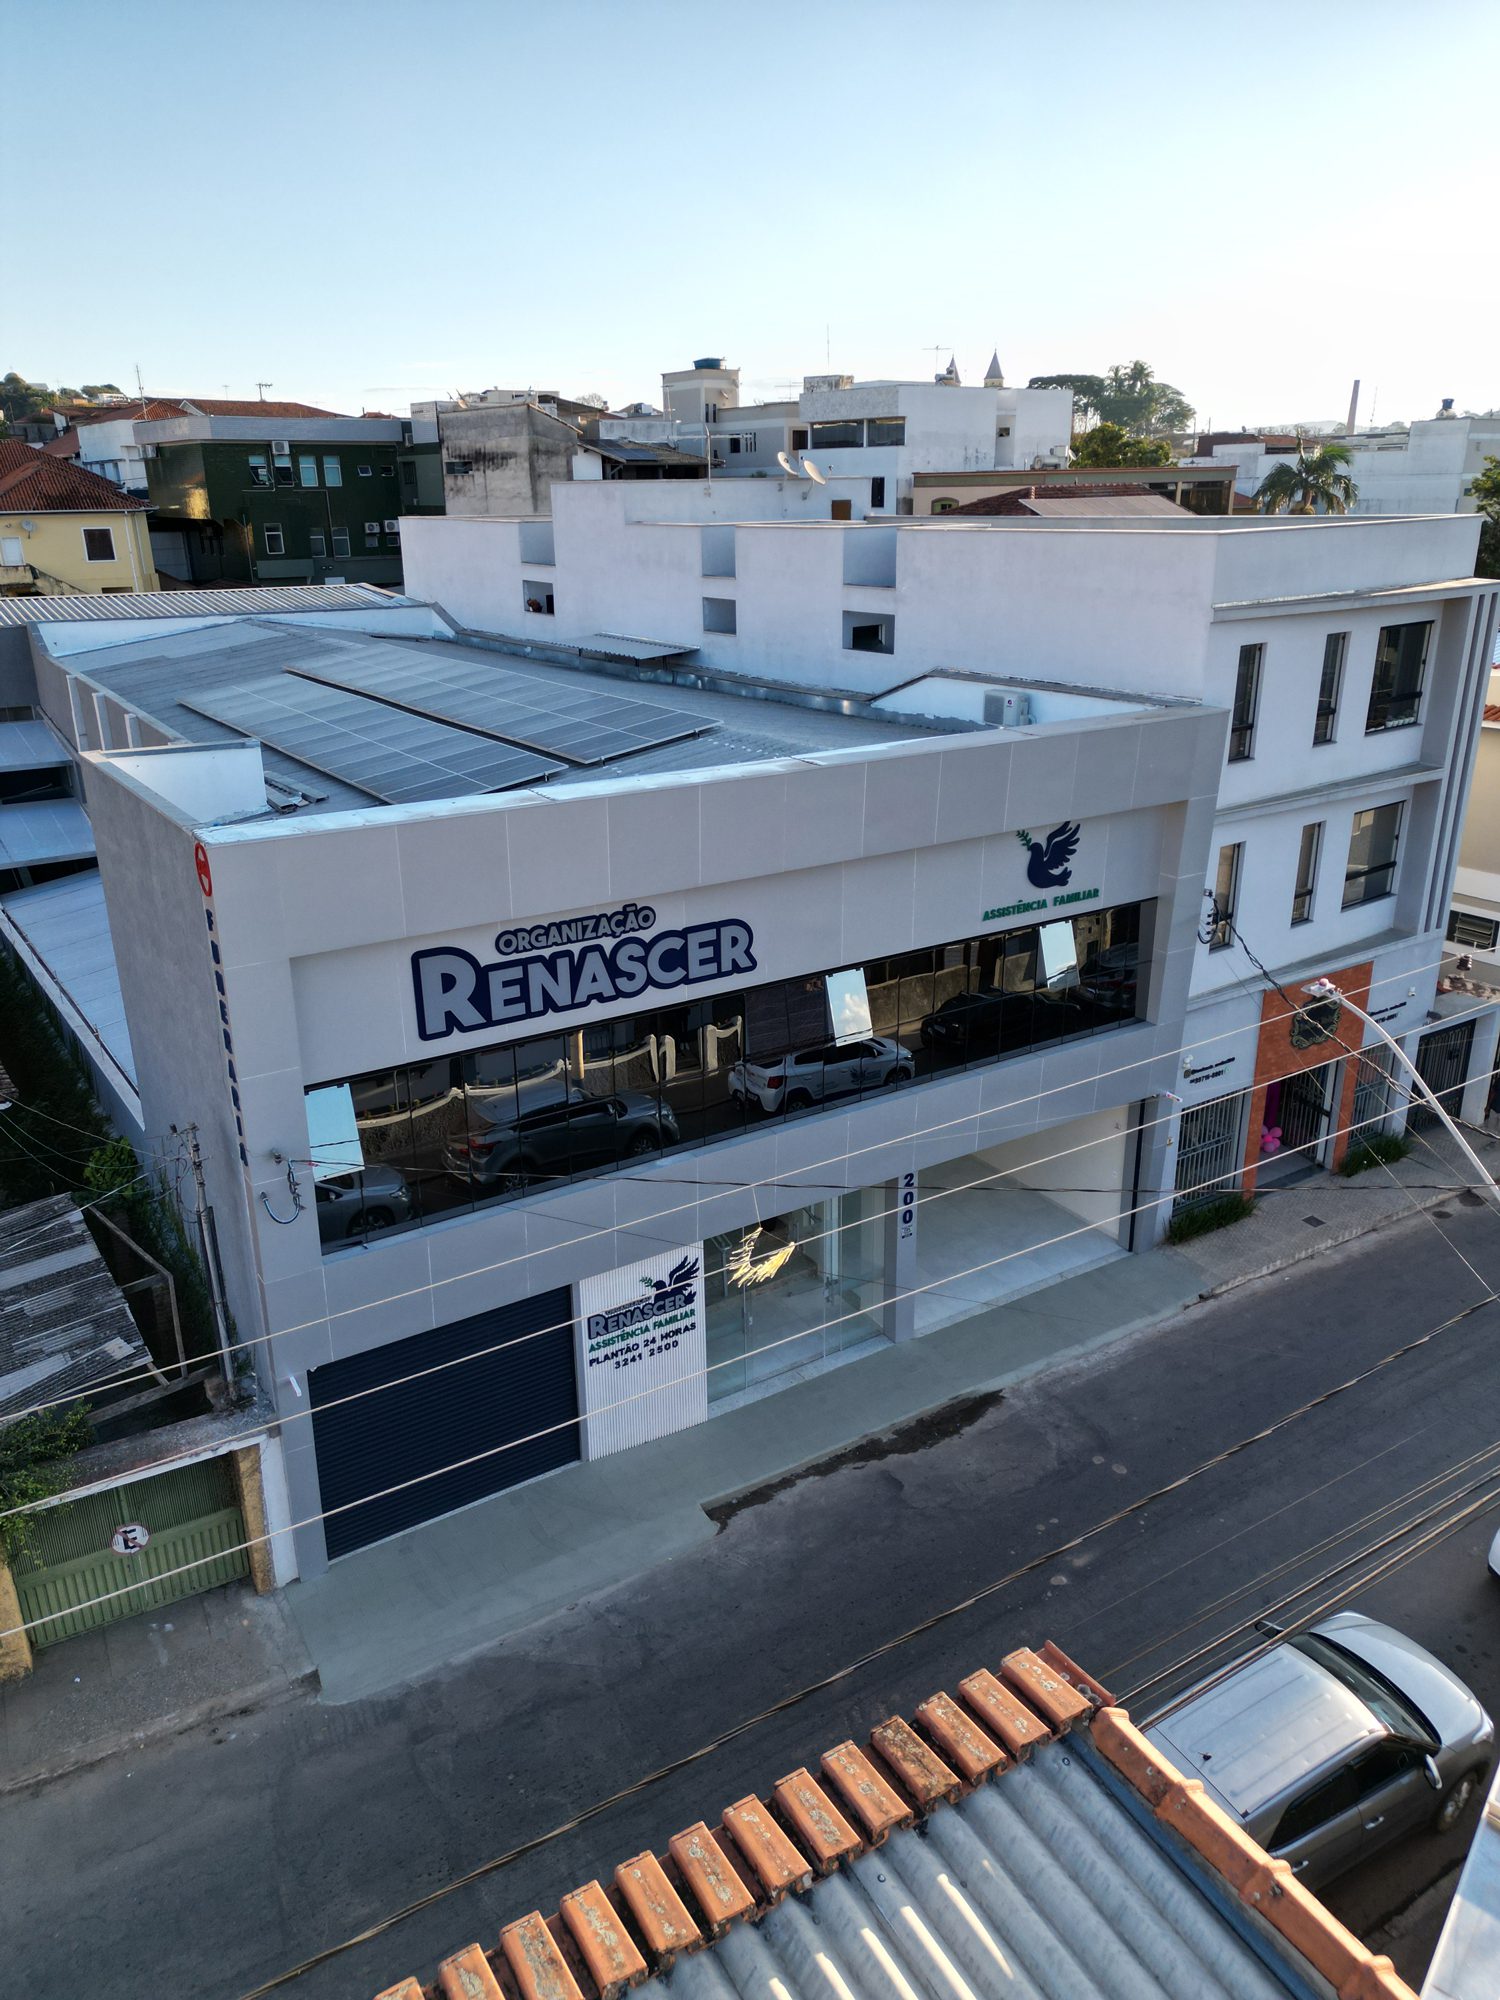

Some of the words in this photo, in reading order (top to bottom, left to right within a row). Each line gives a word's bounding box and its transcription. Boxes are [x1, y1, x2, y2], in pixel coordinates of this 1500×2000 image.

[982, 899, 1047, 921] ASSISTÊNCIA
[1053, 888, 1099, 906] FAMILIAR
[496, 904, 656, 954] ORGANIZAÇÃO
[902, 1172, 914, 1225] 200
[589, 1325, 650, 1353] ASSISTÊNCIA
[653, 1308, 696, 1331] FAMILIAR
[589, 1343, 640, 1367] PLANTÃO
[643, 1336, 657, 1348] 24
[660, 1322, 696, 1341] HORAS
[614, 1353, 643, 1369] 3241
[649, 1339, 679, 1357] 2500
